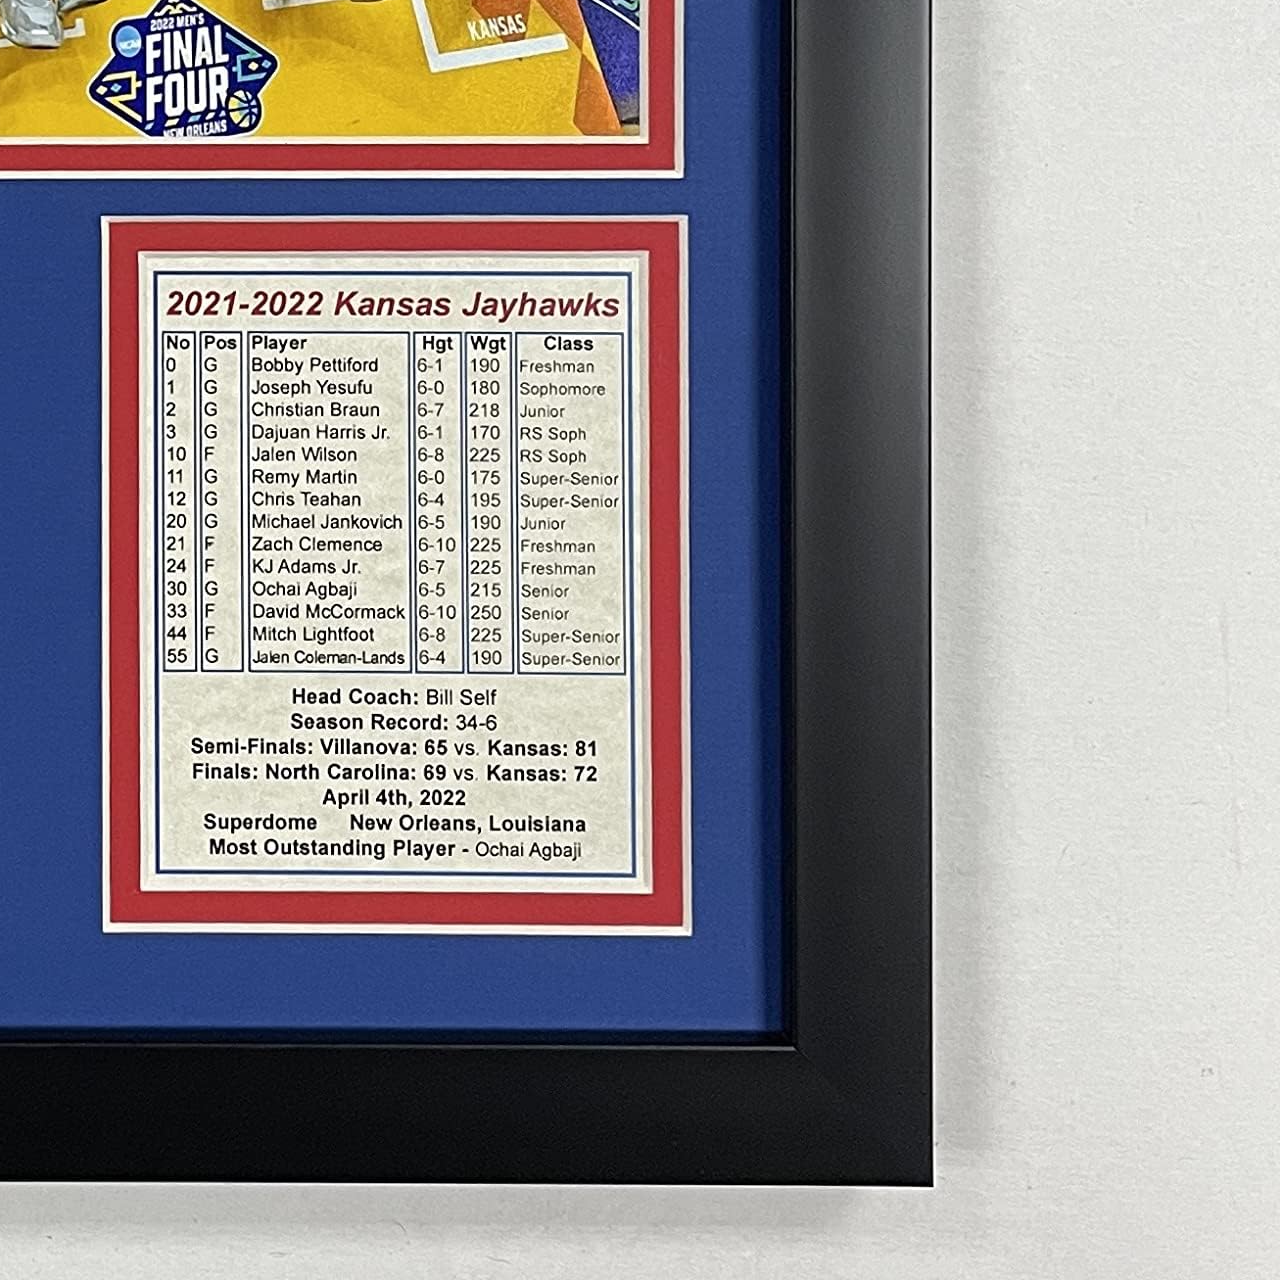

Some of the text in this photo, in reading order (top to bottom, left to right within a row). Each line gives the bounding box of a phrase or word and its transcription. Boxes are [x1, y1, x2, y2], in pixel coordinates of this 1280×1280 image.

[150, 12, 205, 32] 2022 MEN'S
[468, 14, 527, 41] KANSAS
[146, 25, 230, 76] FINAL
[146, 66, 229, 122] FOUR
[186, 120, 228, 138] ORLEANS
[165, 289, 620, 324] 2021-2022 Kansas Jayhawks
[166, 333, 598, 356] No Pos Player Hgt Wgt Class
[251, 356, 595, 377] Bobby Pettiford 6-1 190 Freshman
[251, 379, 606, 399] Joseph Yesufu 6-0 180 Sophomore
[251, 400, 566, 419] Christian Braun 6-7 218 Junior
[251, 423, 587, 444] Dajuan Harris Jr. 6-1 170 RS Soph
[251, 445, 587, 466] Jalen Wilson 6-8 225 RS Soph
[251, 468, 620, 489] Remy Martin 6-0 175 Super-Senior
[251, 490, 620, 511] Chris Teahan 6-4 195 Super-Senior
[251, 512, 567, 531] Michael Jankovich 6-5 190 Junior
[252, 535, 596, 554] Zach Clemence 6-10 225 Freshman
[252, 557, 596, 576] KJ Adams Jr. 6-7 225 Freshman
[252, 580, 570, 601] Ochai Agbaji 6-5 215 Senior
[252, 602, 570, 622] David McCormack 6-10 250 Senior
[252, 625, 621, 647] Mitch Lightfoot 6-8 225 Super-Senior
[252, 647, 621, 669] Jalen Coleman-Lands 6-4 190 Super-Senior
[291, 687, 498, 706] Head Coach: Bill Self
[290, 711, 498, 732] Season Record: 34-6
[190, 735, 598, 757] Semi-Finals: Villanova: 65 vs. Kansas: 81
[192, 762, 598, 783] Finals: North Carolina: 69 vs. Kansas: 72
[320, 787, 467, 810] April 4th, 2022
[202, 812, 587, 836] Superdome New Orleans, Louisiana
[209, 837, 583, 862] Most Outstanding Player Ochai Agbaji
